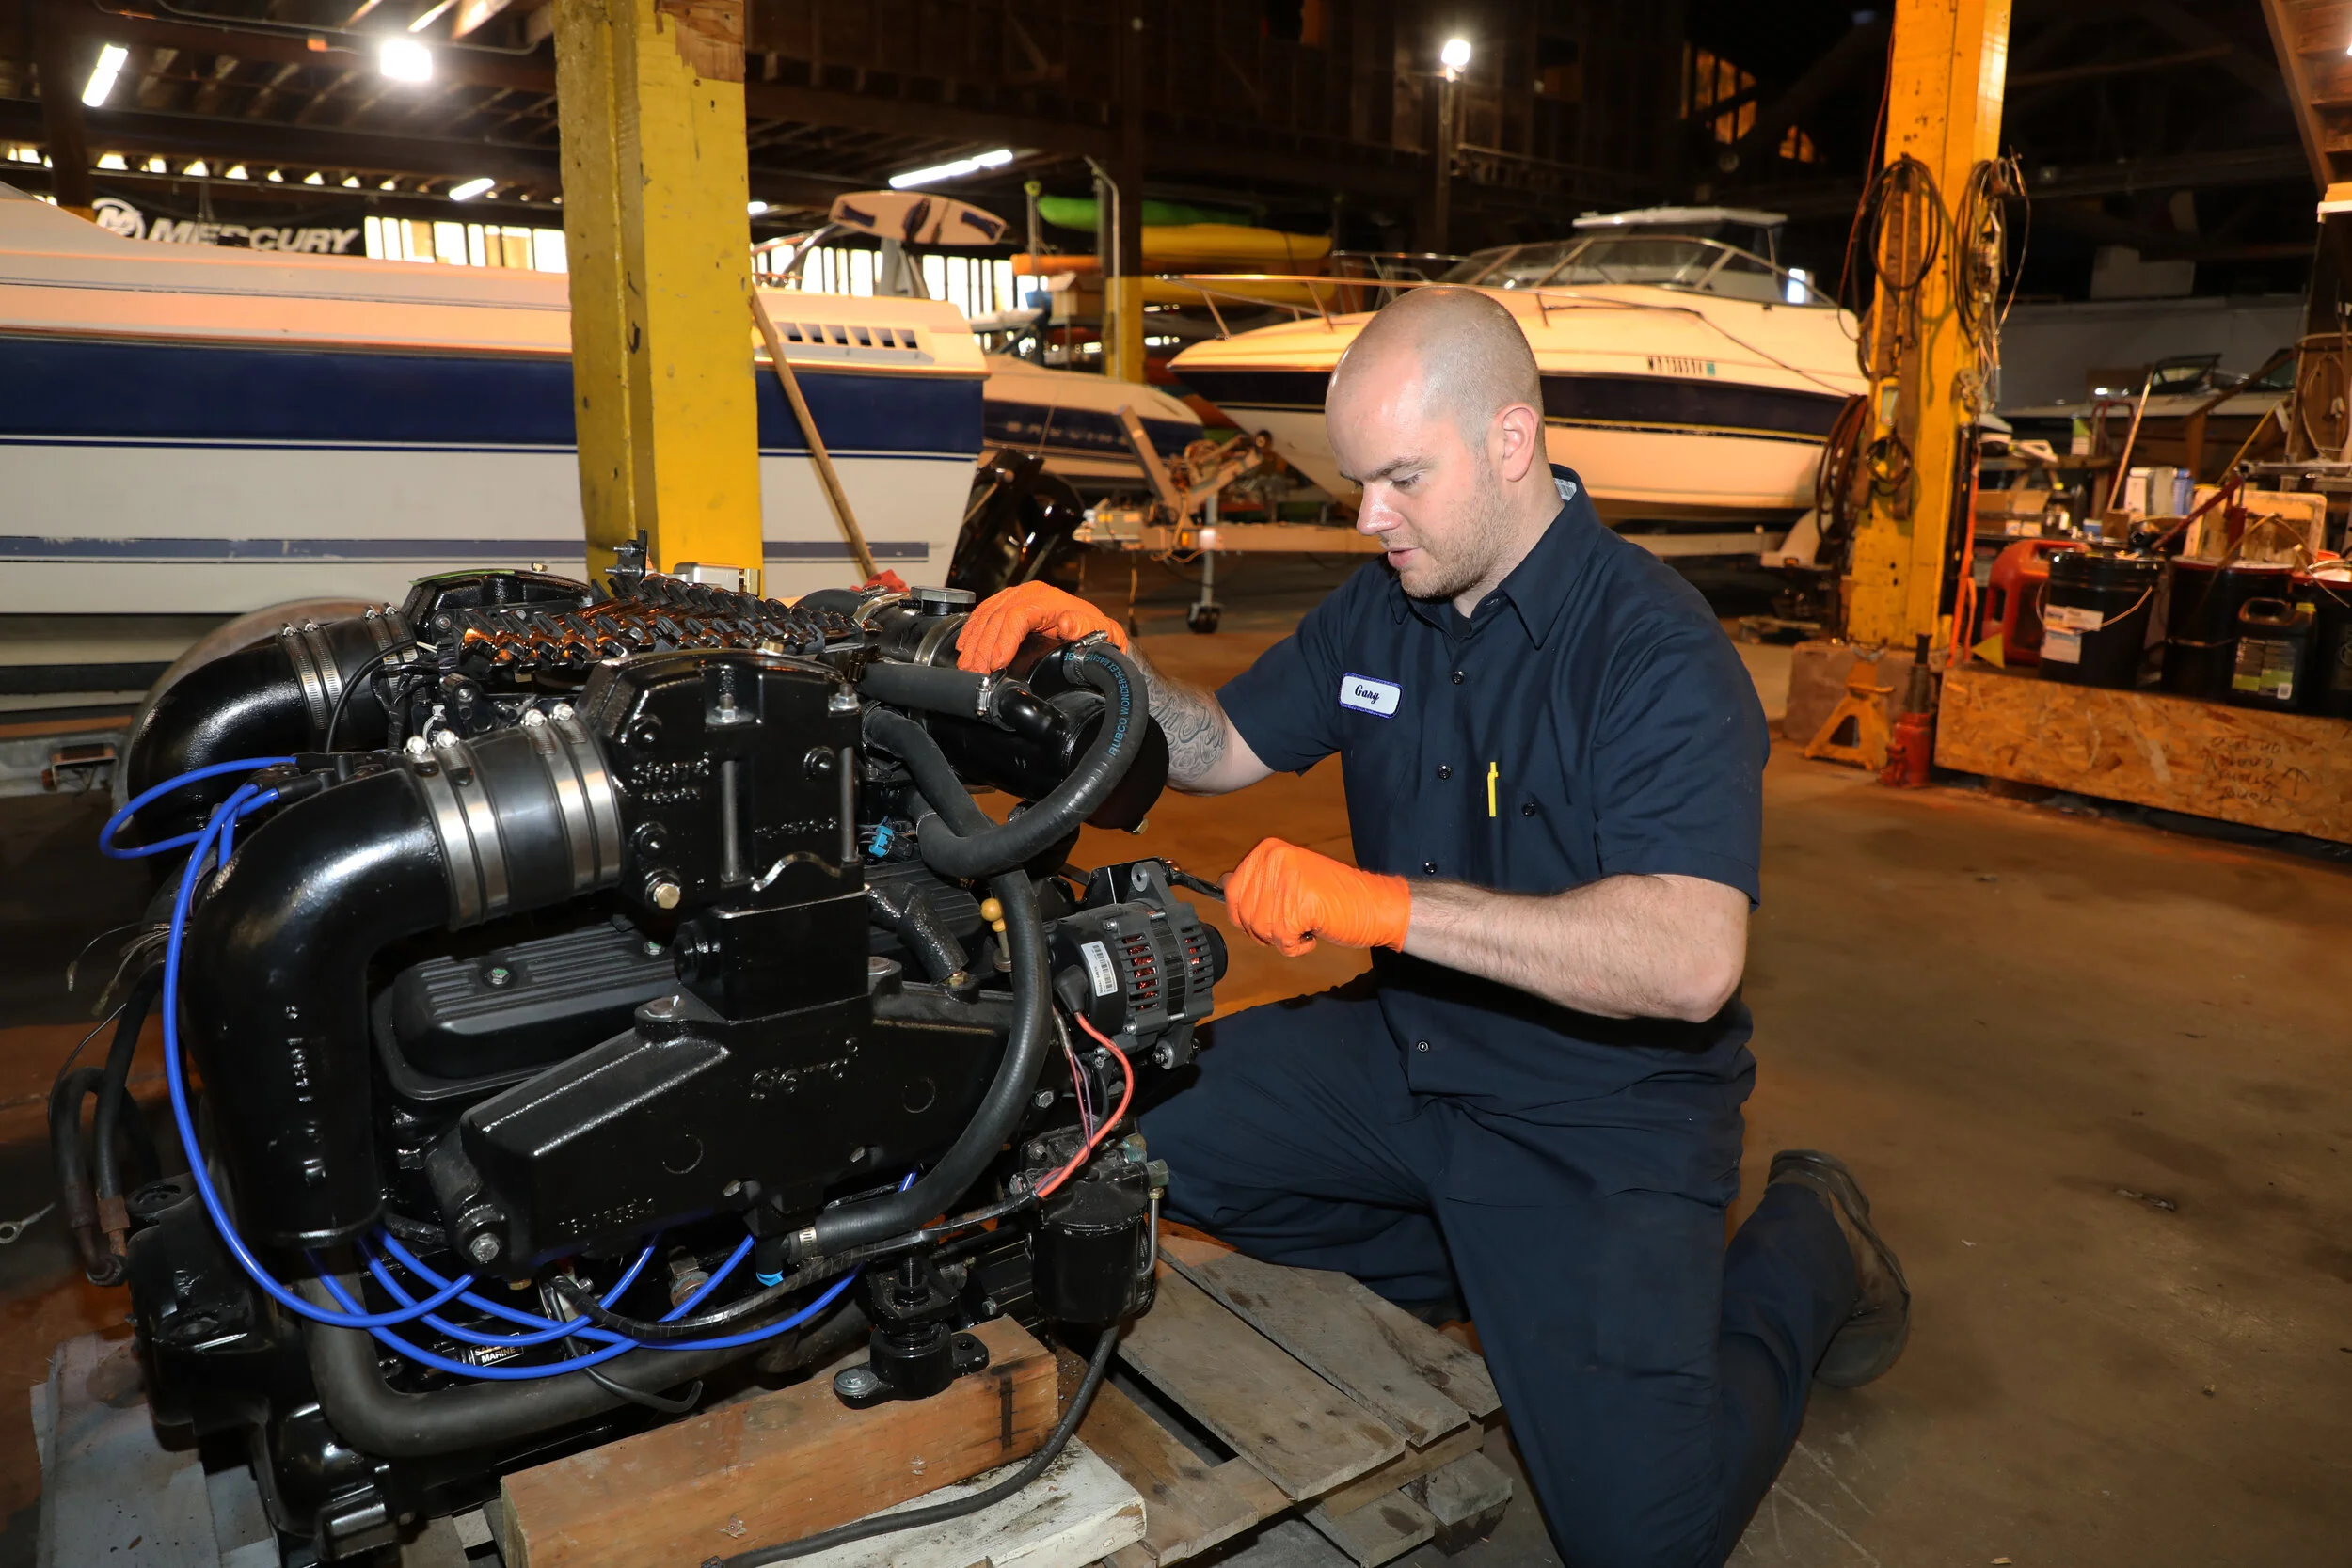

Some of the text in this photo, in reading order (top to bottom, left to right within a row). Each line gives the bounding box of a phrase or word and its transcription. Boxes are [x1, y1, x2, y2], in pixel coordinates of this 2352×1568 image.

[1354, 684, 1380, 705] Gary
[1108, 717, 1128, 756] RUBCO
[481, 1346, 516, 1363] MARINE
